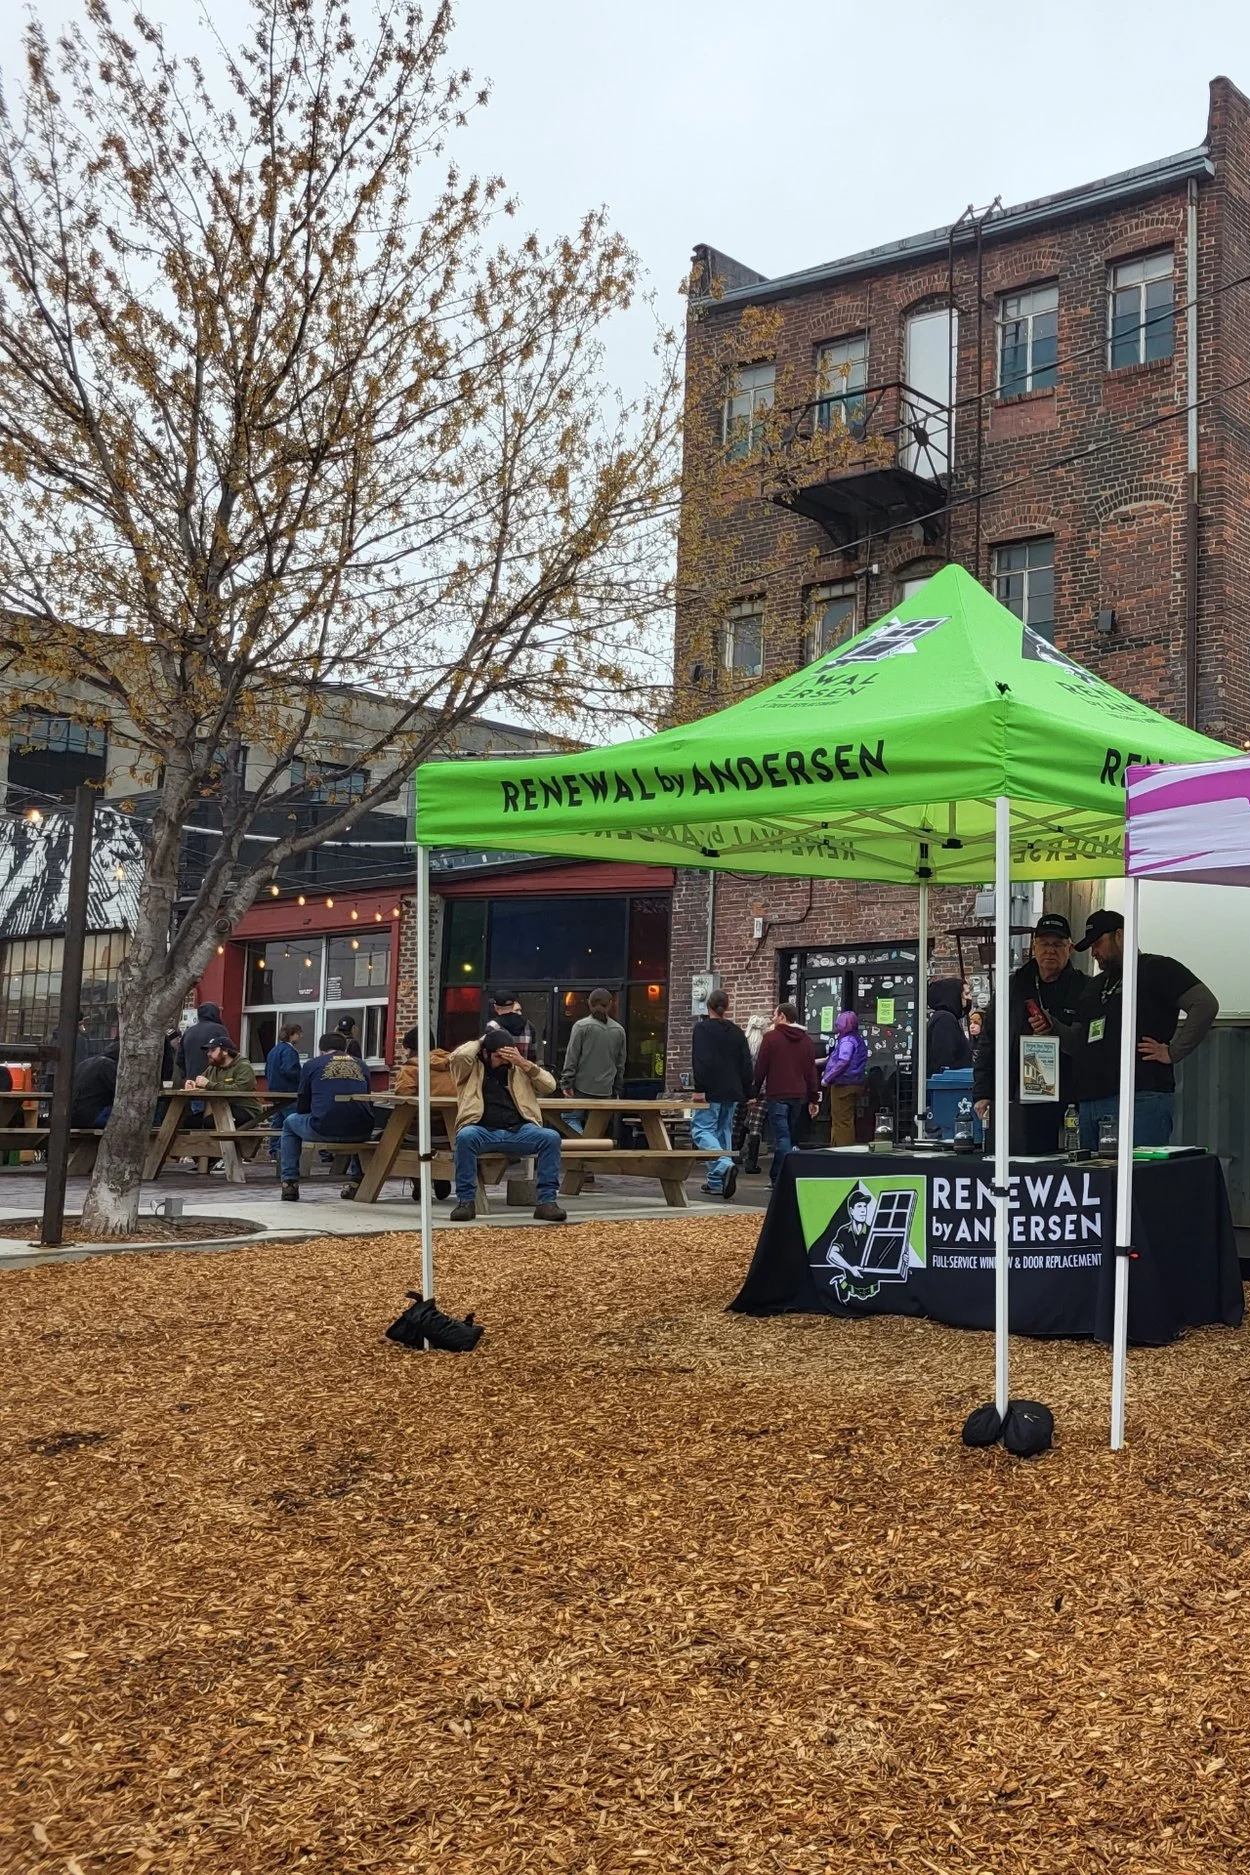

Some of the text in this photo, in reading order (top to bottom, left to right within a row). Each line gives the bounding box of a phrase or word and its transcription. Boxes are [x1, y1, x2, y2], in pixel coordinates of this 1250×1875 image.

[502, 739, 890, 813] RENEWAL by ANDERSEN
[932, 1172, 1101, 1210] RENEWAL
[932, 1212, 1102, 1242] by ANERSEN
[932, 1252, 1103, 1270] FULL-SERVICE WINW & DOOR REPLACEMENT
